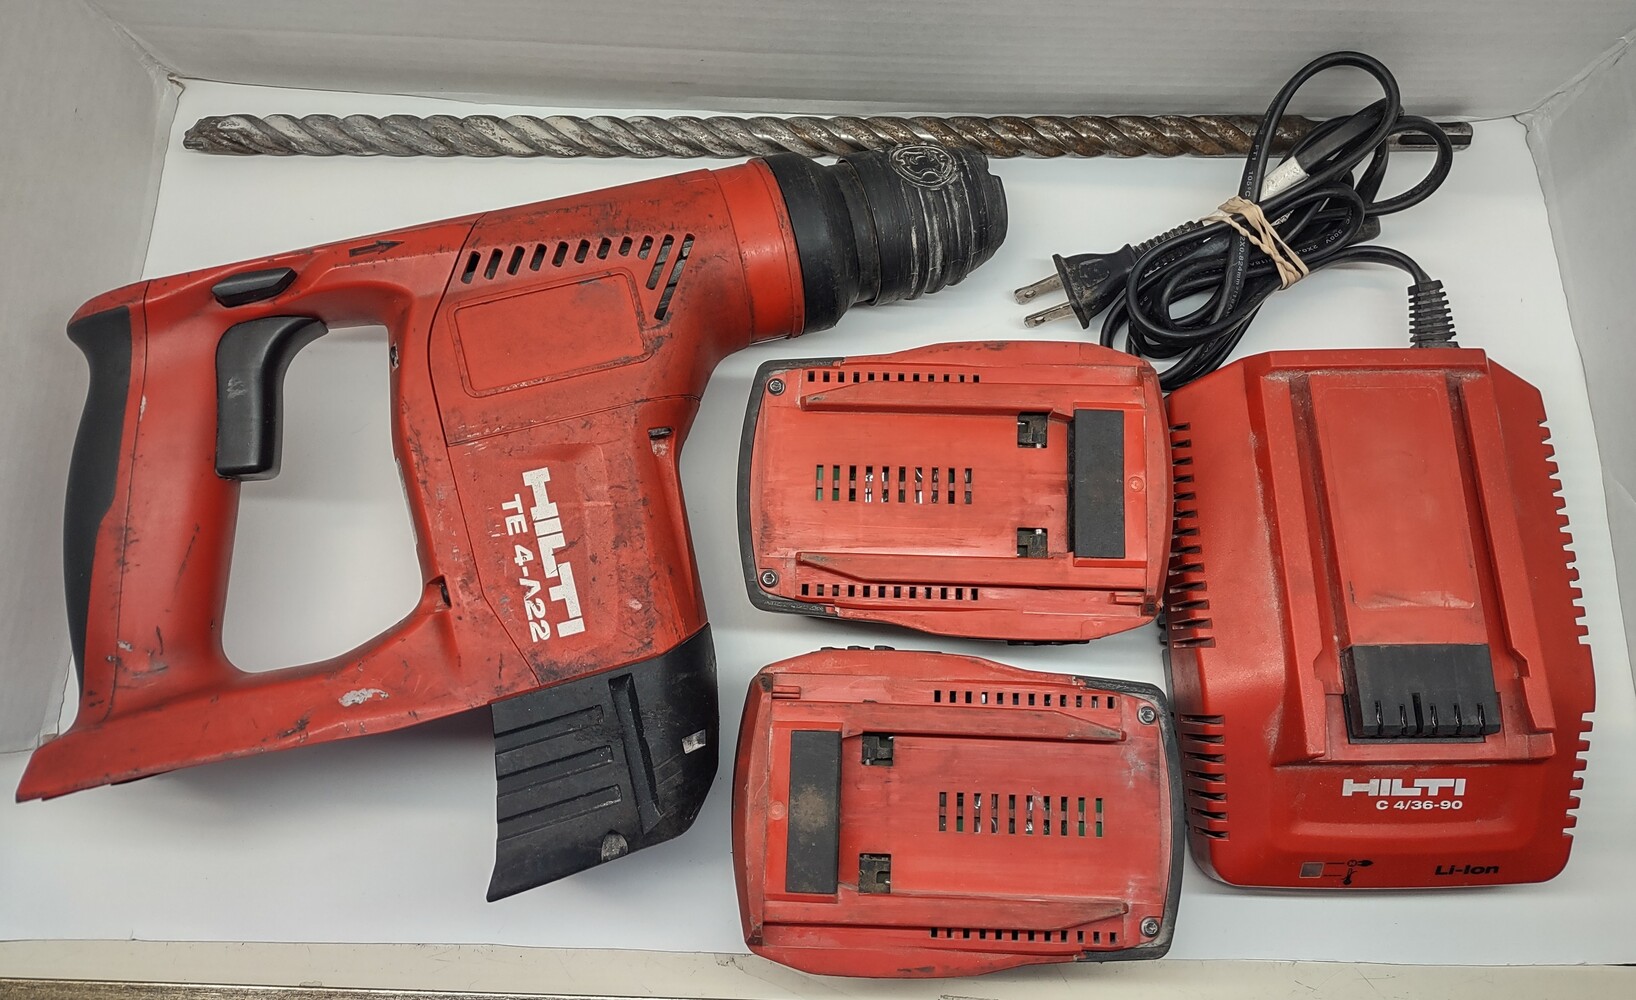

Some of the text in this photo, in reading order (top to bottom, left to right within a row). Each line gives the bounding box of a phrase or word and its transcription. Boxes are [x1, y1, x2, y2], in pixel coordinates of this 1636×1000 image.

[522, 467, 585, 638] HILTI
[502, 493, 551, 643] TE 4-A22
[1342, 778, 1467, 796] HILTI
[1376, 800, 1463, 810] C 4/36-90
[1434, 864, 1499, 876] Li-Ion
